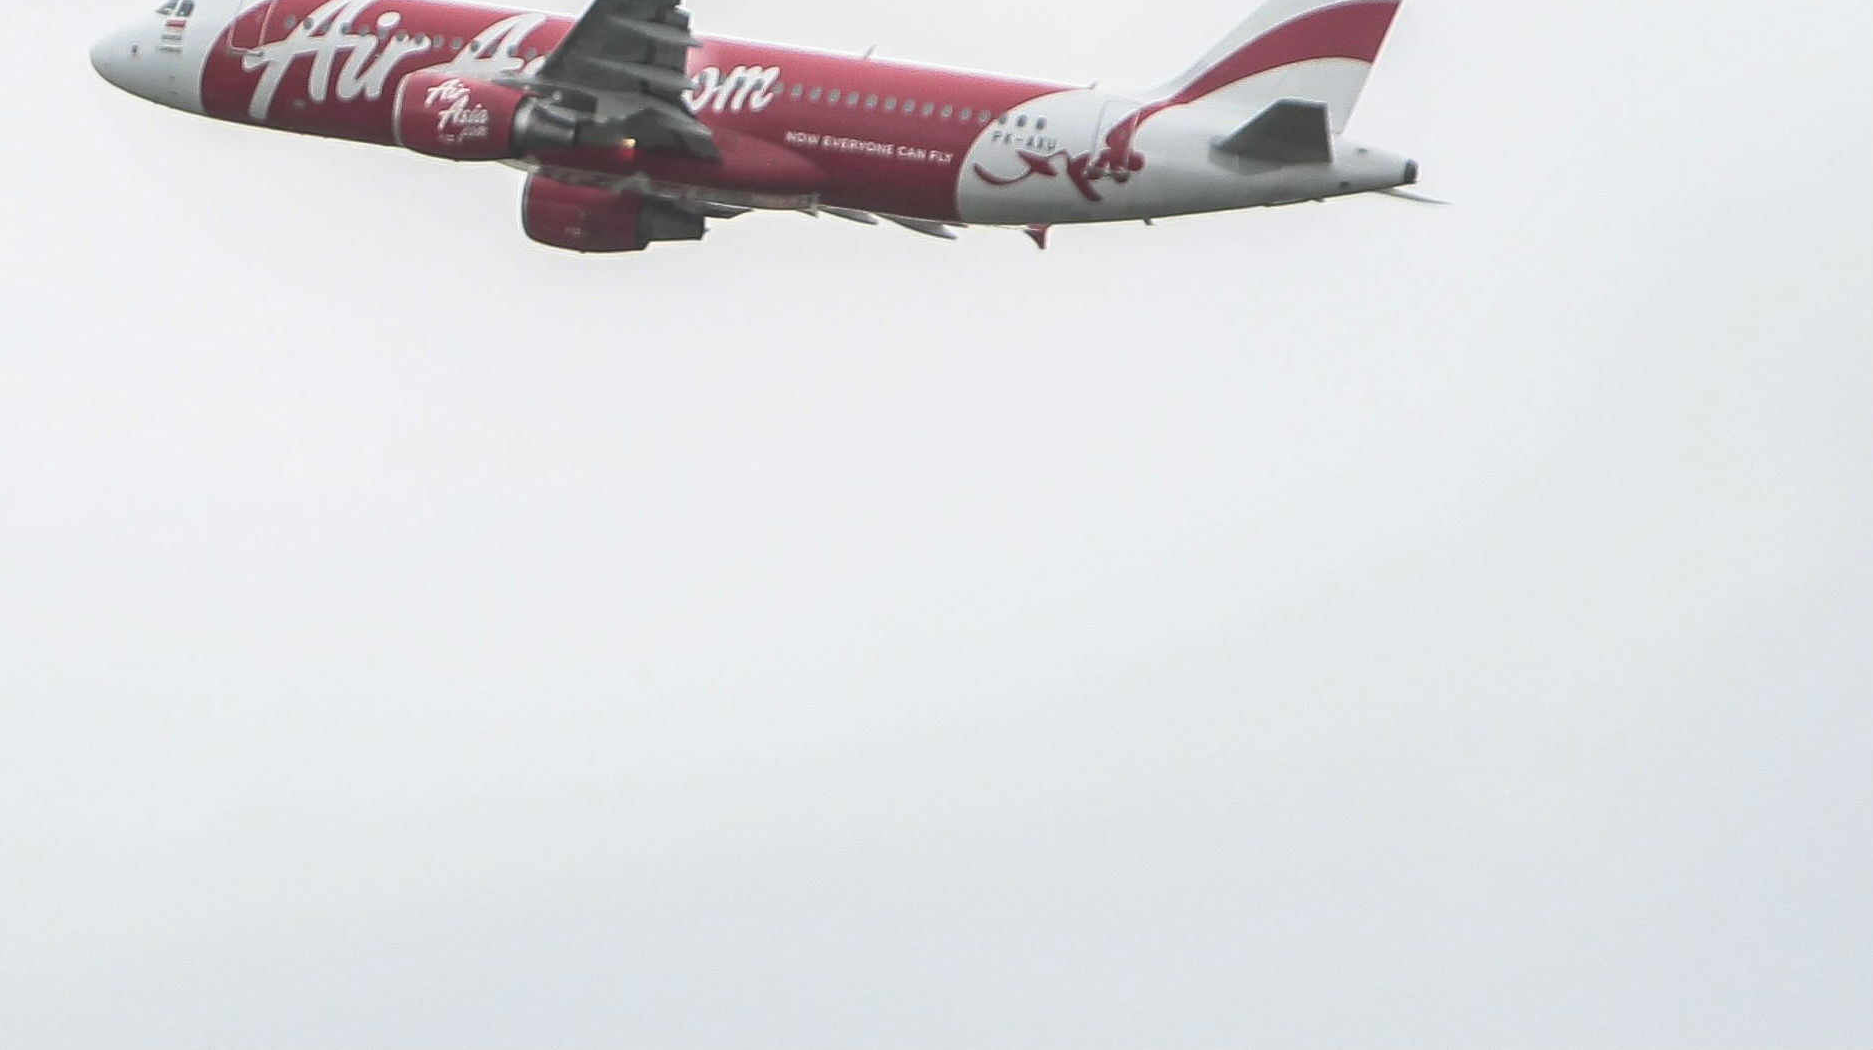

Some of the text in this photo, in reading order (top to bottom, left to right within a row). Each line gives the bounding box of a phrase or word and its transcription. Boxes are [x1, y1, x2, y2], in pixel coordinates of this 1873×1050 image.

[425, 78, 471, 108] Air
[438, 95, 488, 130] Asia
[785, 130, 954, 165] NOW EVERYONE CAN FLY
